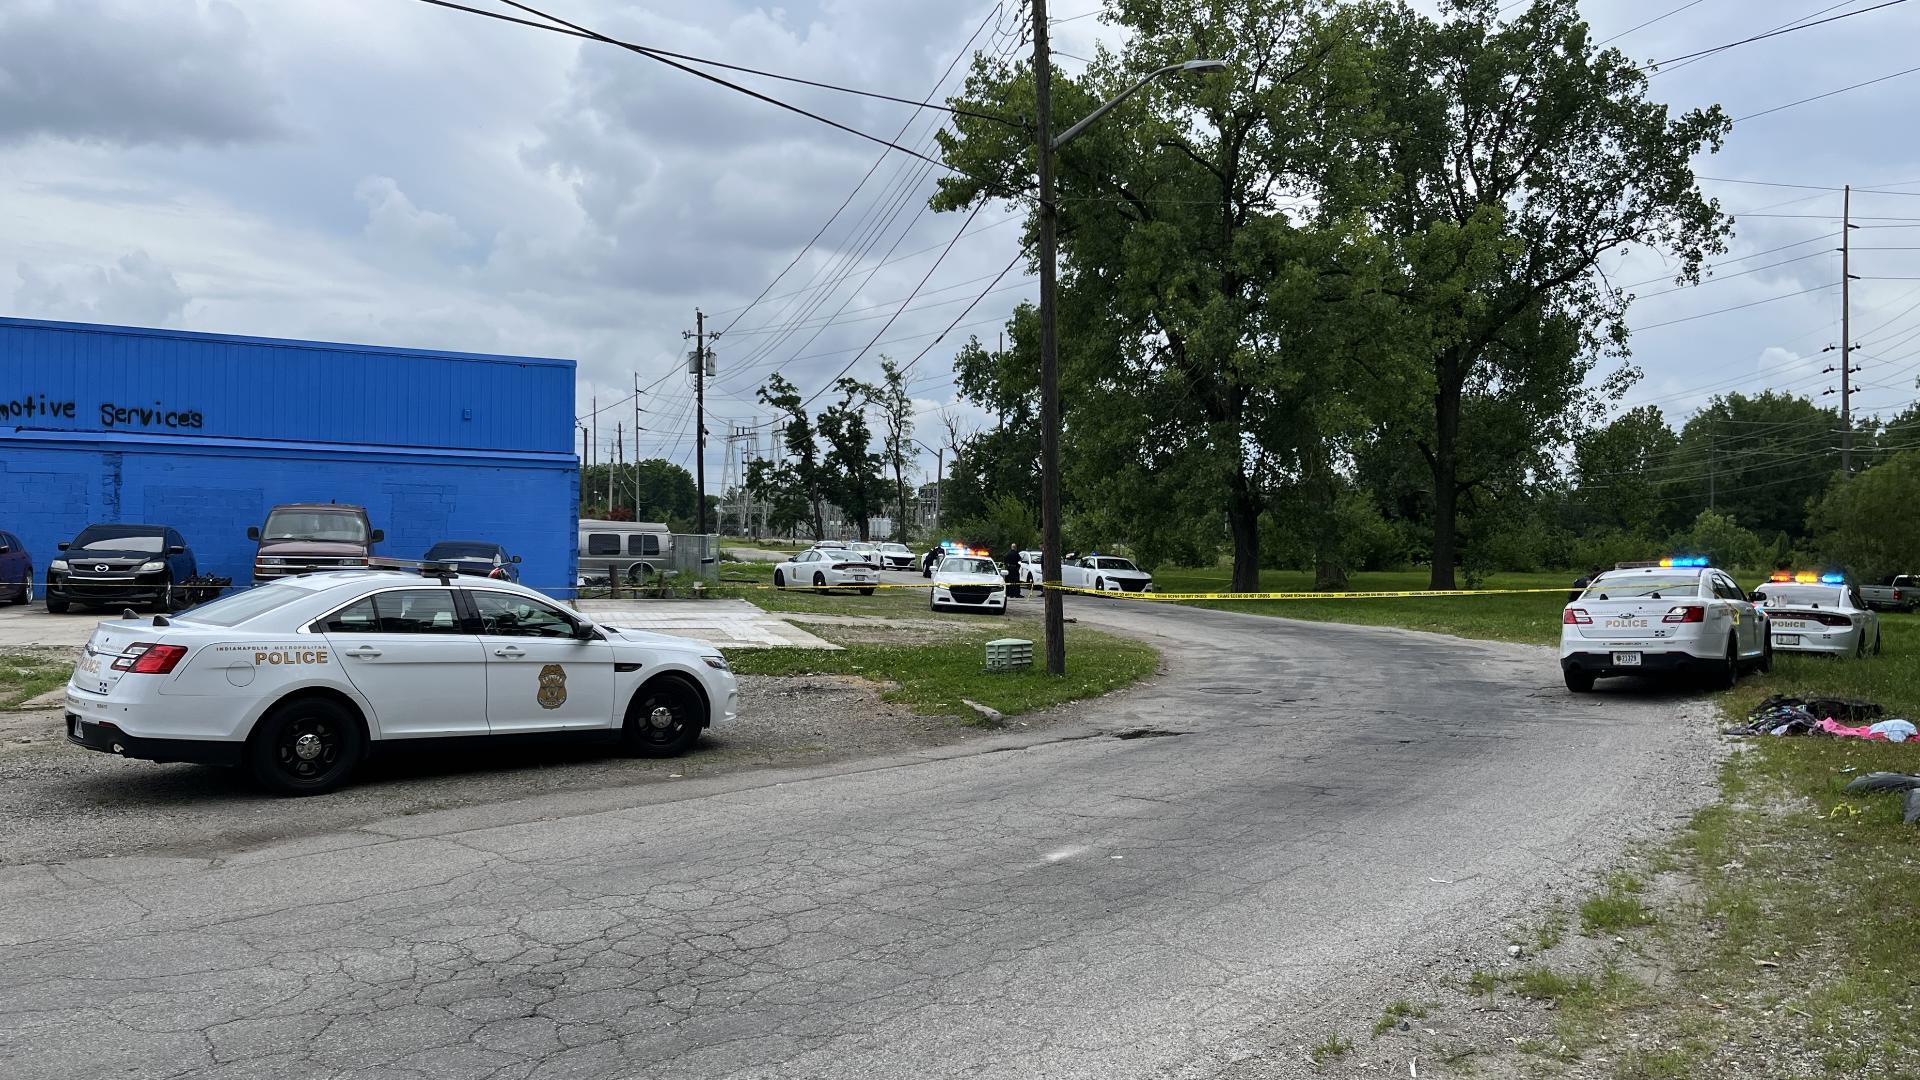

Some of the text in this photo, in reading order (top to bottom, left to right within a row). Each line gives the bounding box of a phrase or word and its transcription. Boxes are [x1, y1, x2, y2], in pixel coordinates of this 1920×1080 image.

[1605, 619, 1648, 628] POLICE
[1771, 620, 1806, 628] POLICE
[255, 651, 328, 665] POLICE
